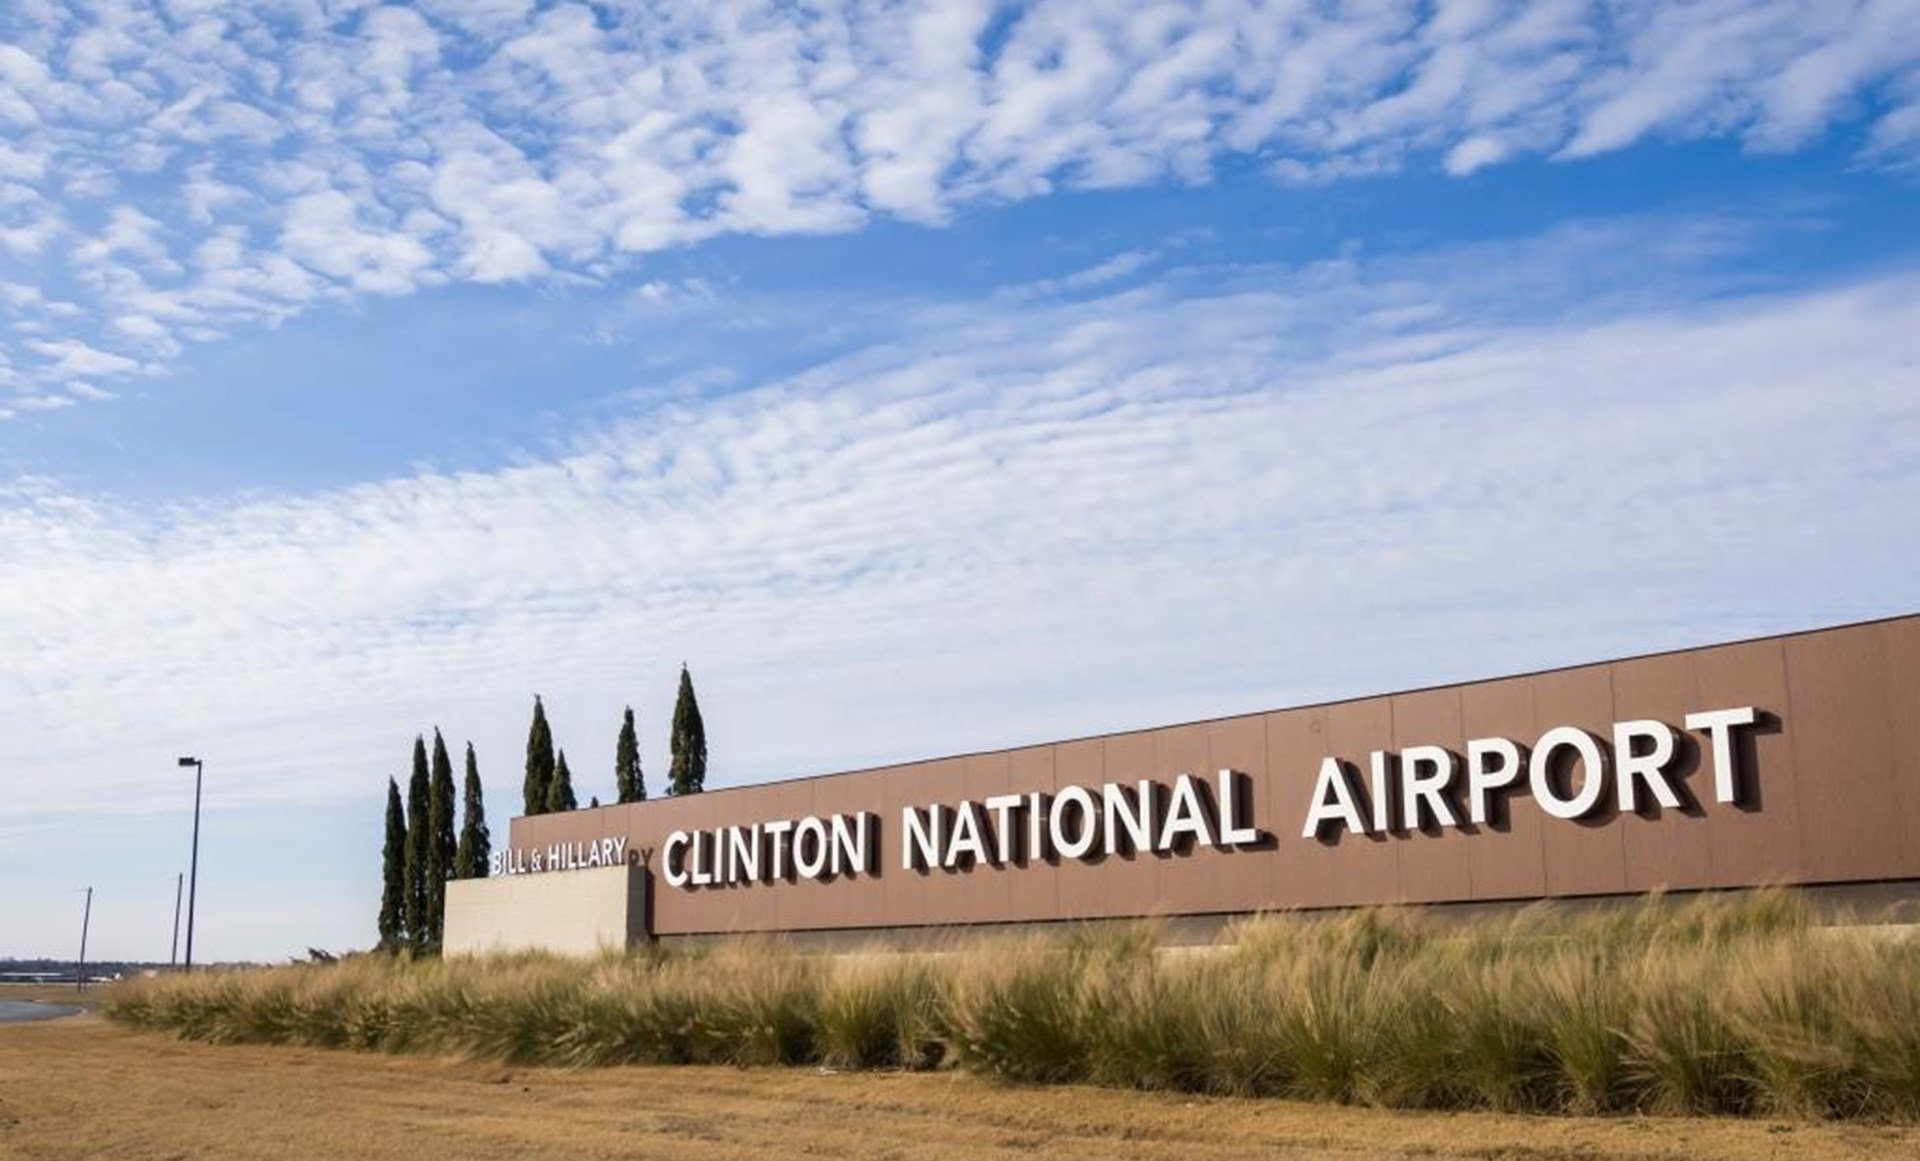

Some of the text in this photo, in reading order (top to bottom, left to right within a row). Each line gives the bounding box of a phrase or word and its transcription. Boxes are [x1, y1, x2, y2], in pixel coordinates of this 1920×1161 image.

[662, 706, 1755, 888] CLINTON NATIONAL AIRPORT
[493, 836, 627, 875] BILL & HILLARY
